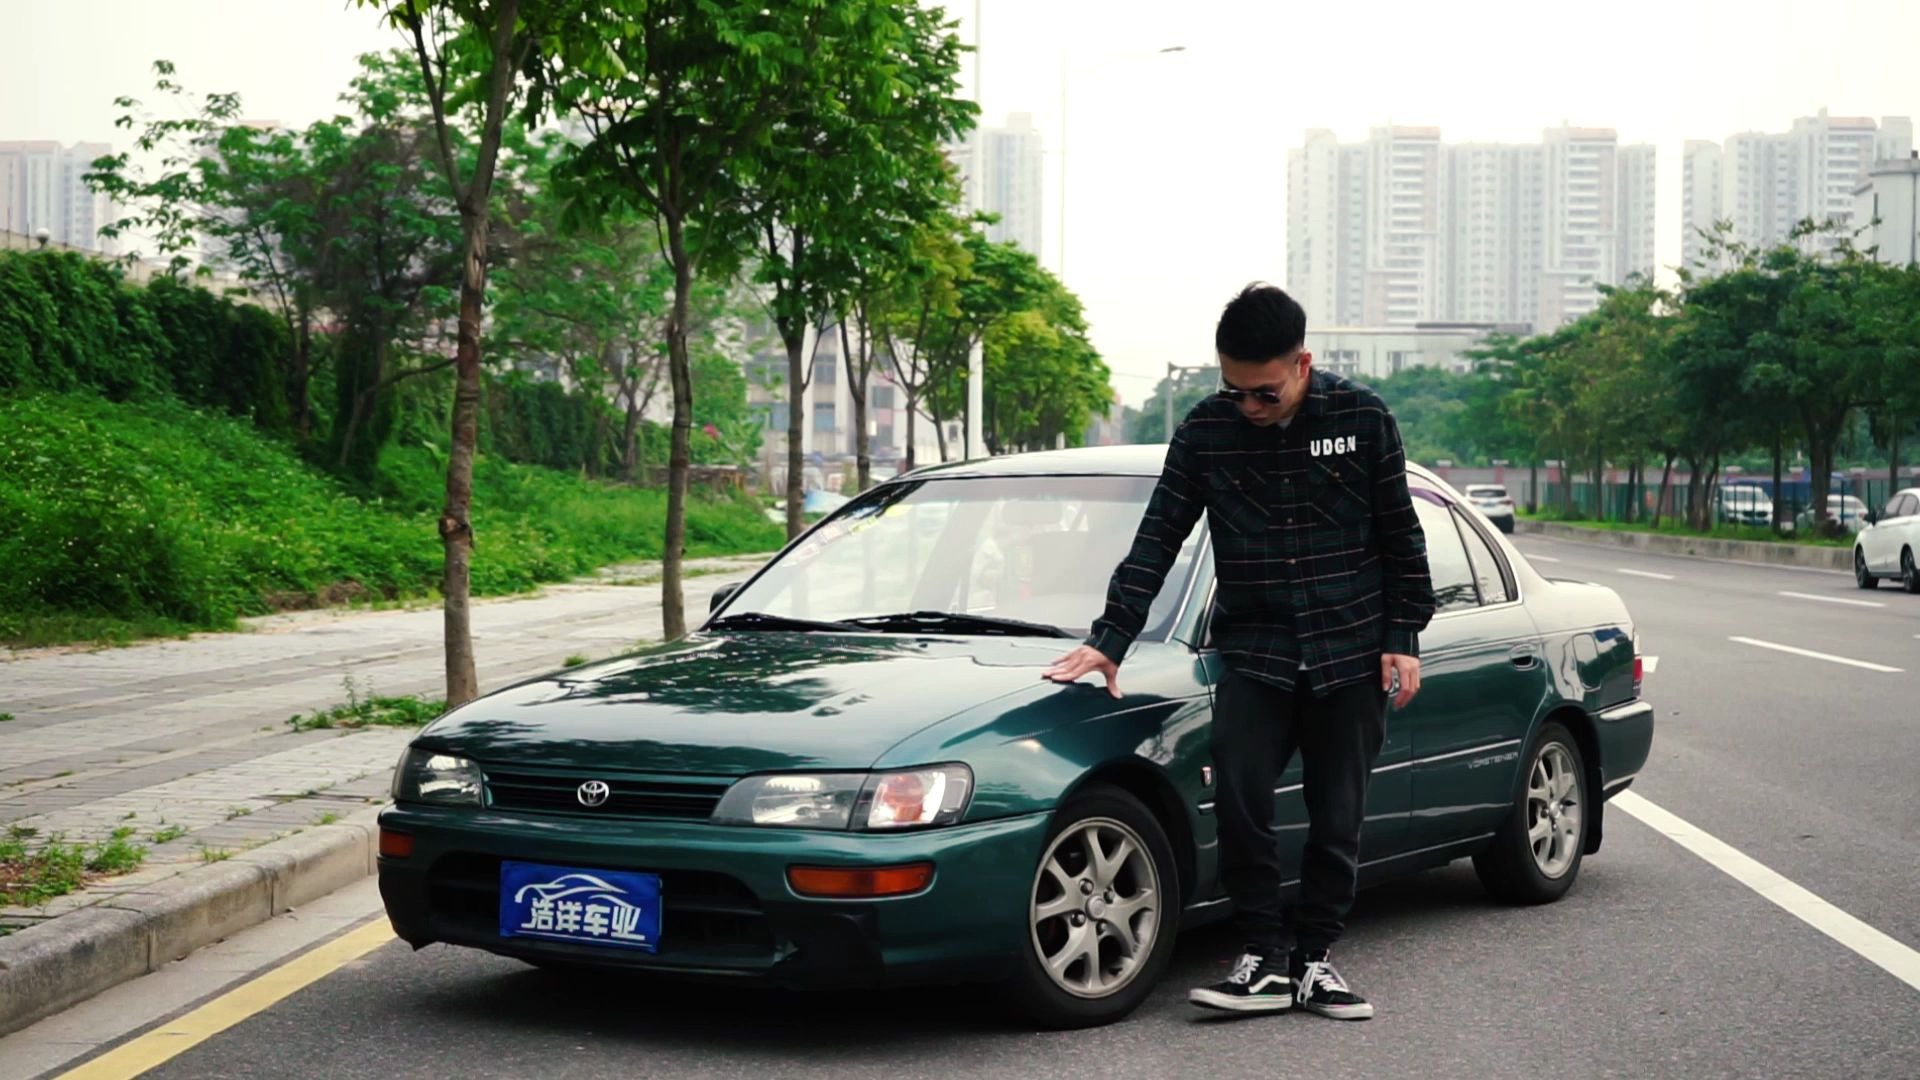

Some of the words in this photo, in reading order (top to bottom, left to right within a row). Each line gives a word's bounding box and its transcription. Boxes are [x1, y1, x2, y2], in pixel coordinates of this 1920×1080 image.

[1310, 435, 1357, 457] UDGN
[520, 897, 646, 941] 浩洋车业
